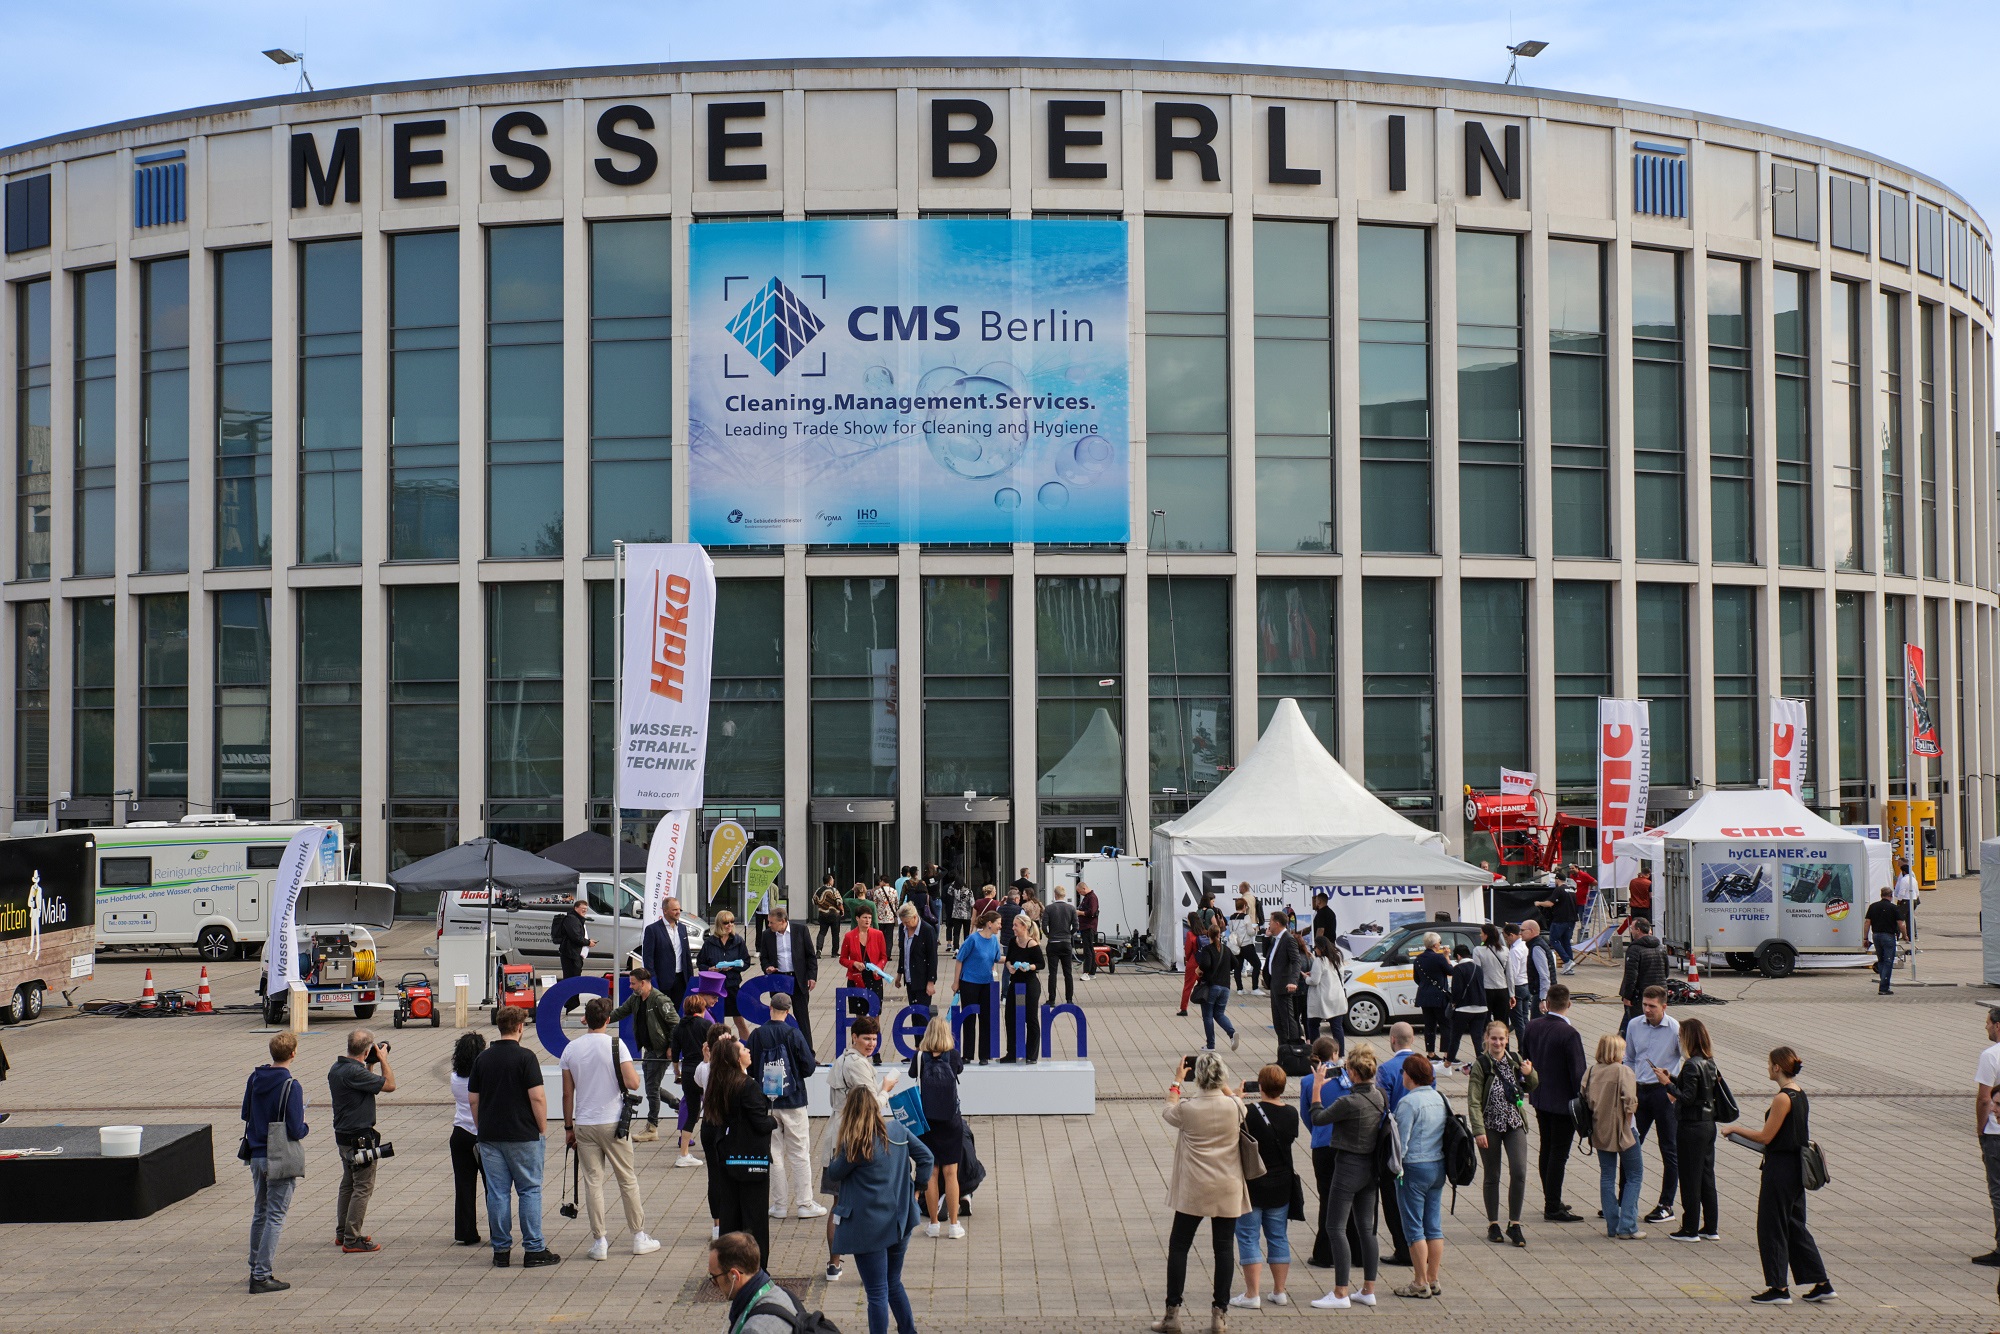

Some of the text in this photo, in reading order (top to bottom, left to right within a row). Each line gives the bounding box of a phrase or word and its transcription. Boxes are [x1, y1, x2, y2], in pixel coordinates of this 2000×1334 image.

[291, 98, 1522, 209] MESSE BERLIN
[847, 305, 1094, 342] CMS Berlin
[725, 419, 1099, 440] Leading Trade Show for Cleaning and Hygiene
[857, 508, 878, 520] IHO
[650, 569, 691, 704] Hako
[629, 723, 699, 739] WASSER-
[628, 739, 697, 755] STRAHL-
[626, 756, 698, 771] TECHNIK
[1502, 775, 1533, 787] cmc
[636, 789, 680, 800] hako.com
[1687, 791, 1694, 800] B
[61, 801, 67, 810] D
[132, 802, 139, 811] D
[1720, 826, 1805, 838] cmc
[666, 846, 677, 868] 200
[672, 823, 681, 845] A/B
[713, 847, 732, 873] What to
[154, 862, 244, 880] Reinigungstechnik
[656, 871, 662, 881] in
[96, 883, 235, 905] hne Hochdruck, ohne Wasser, ohne Chemie
[460, 890, 489, 900] Hako
[1231, 883, 1298, 894] RNIGUNGS
[0, 894, 67, 932] ritten Mafia
[277, 841, 310, 977] Wasserstrahltechnik
[514, 923, 553, 931] Reinigungstec
[536, 974, 801, 1060] CS
